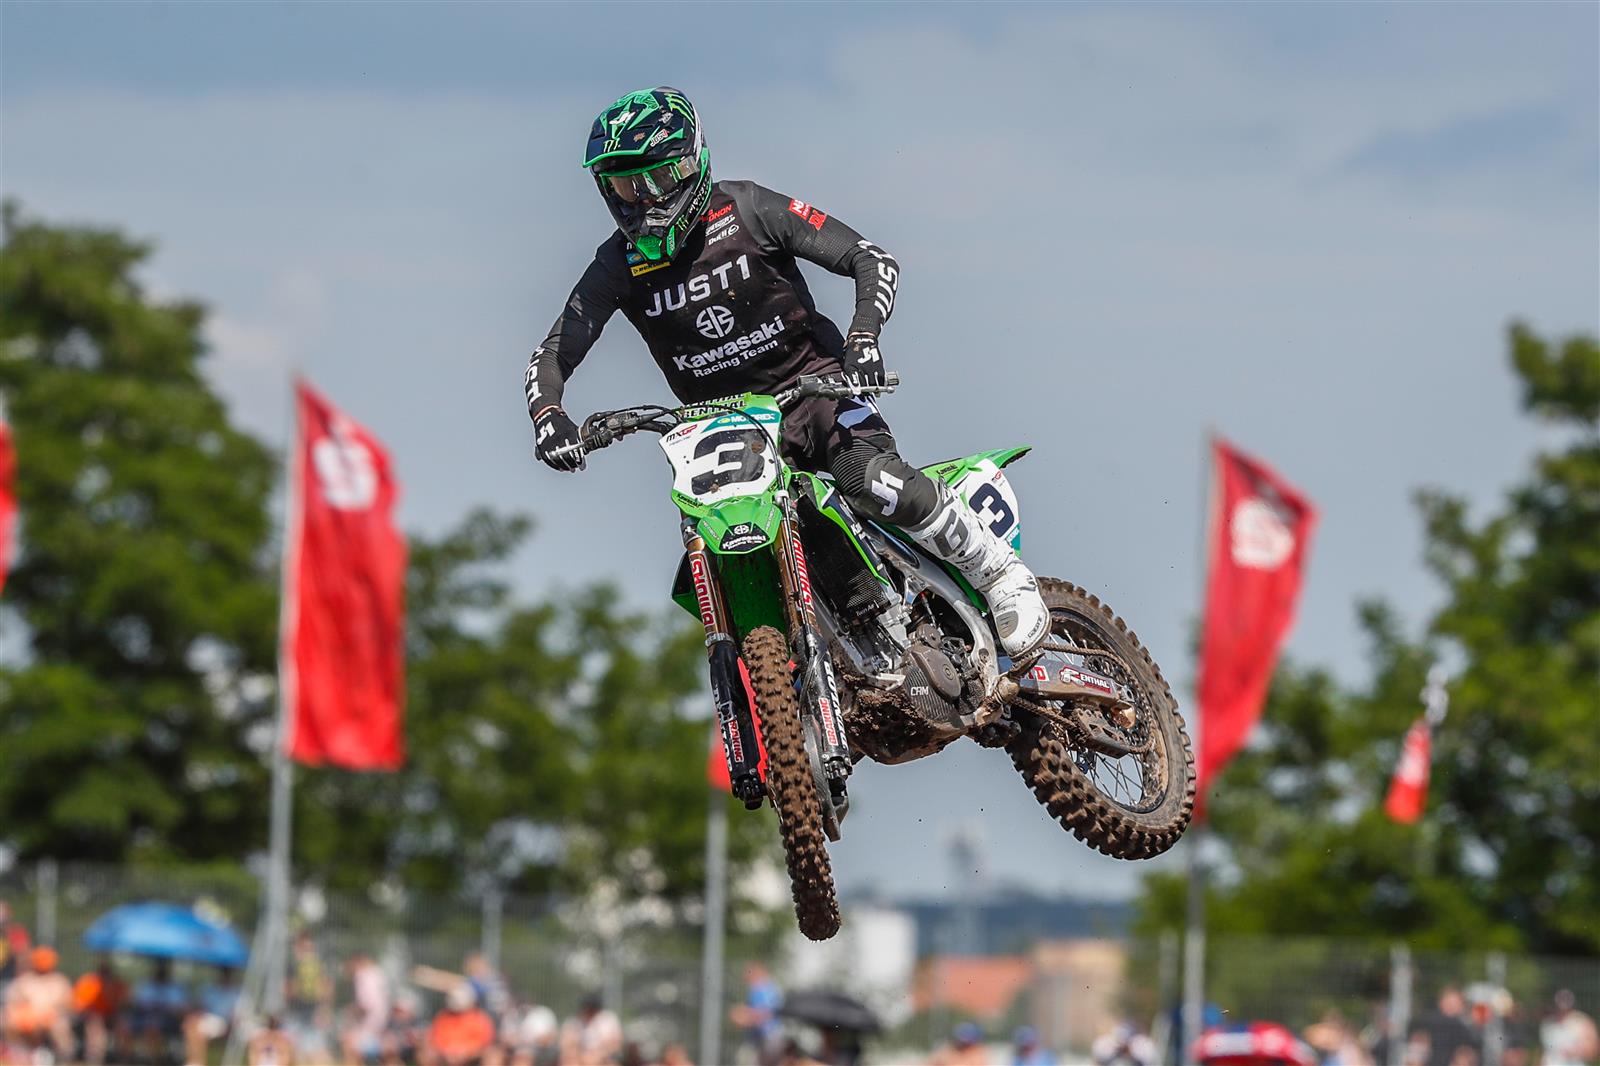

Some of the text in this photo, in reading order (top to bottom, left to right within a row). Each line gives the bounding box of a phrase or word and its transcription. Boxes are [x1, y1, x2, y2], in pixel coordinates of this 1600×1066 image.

[645, 254, 750, 317] JUST1
[672, 315, 786, 371] Kawasaki
[692, 339, 779, 377] Racing Team
[691, 428, 767, 496] 3
[968, 482, 1015, 538] 3
[722, 535, 767, 550] Kawasaki
[691, 559, 715, 626] SHOWA
[819, 698, 838, 746] BRAKING
[824, 660, 849, 750] DUNLOP
